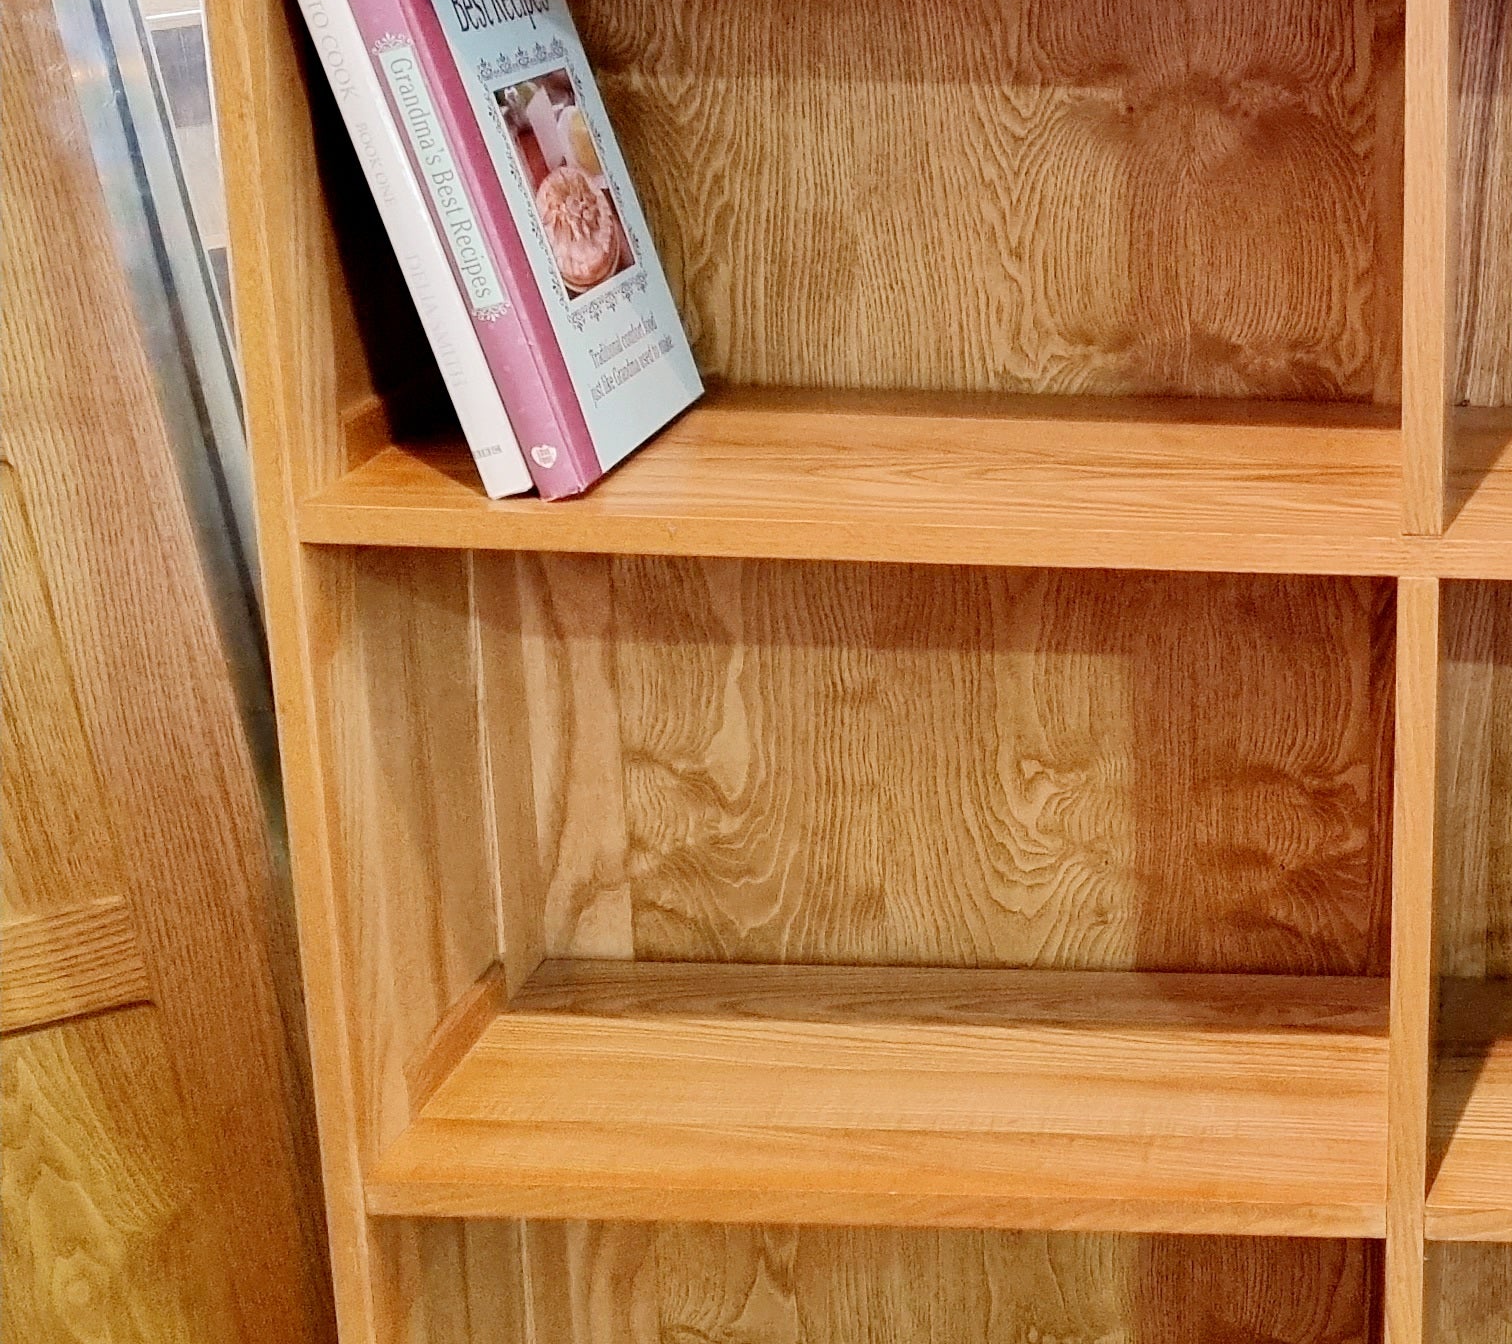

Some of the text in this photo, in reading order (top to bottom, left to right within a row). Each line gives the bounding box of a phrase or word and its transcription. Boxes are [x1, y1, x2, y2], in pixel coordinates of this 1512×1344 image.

[321, 35, 357, 102] COOK
[355, 122, 396, 204] BOOK ONE
[390, 57, 492, 299] Grandma's Best Recipes
[640, 310, 658, 335] food
[586, 381, 606, 408] just
[601, 373, 616, 394] like
[612, 359, 642, 386] Grandma
